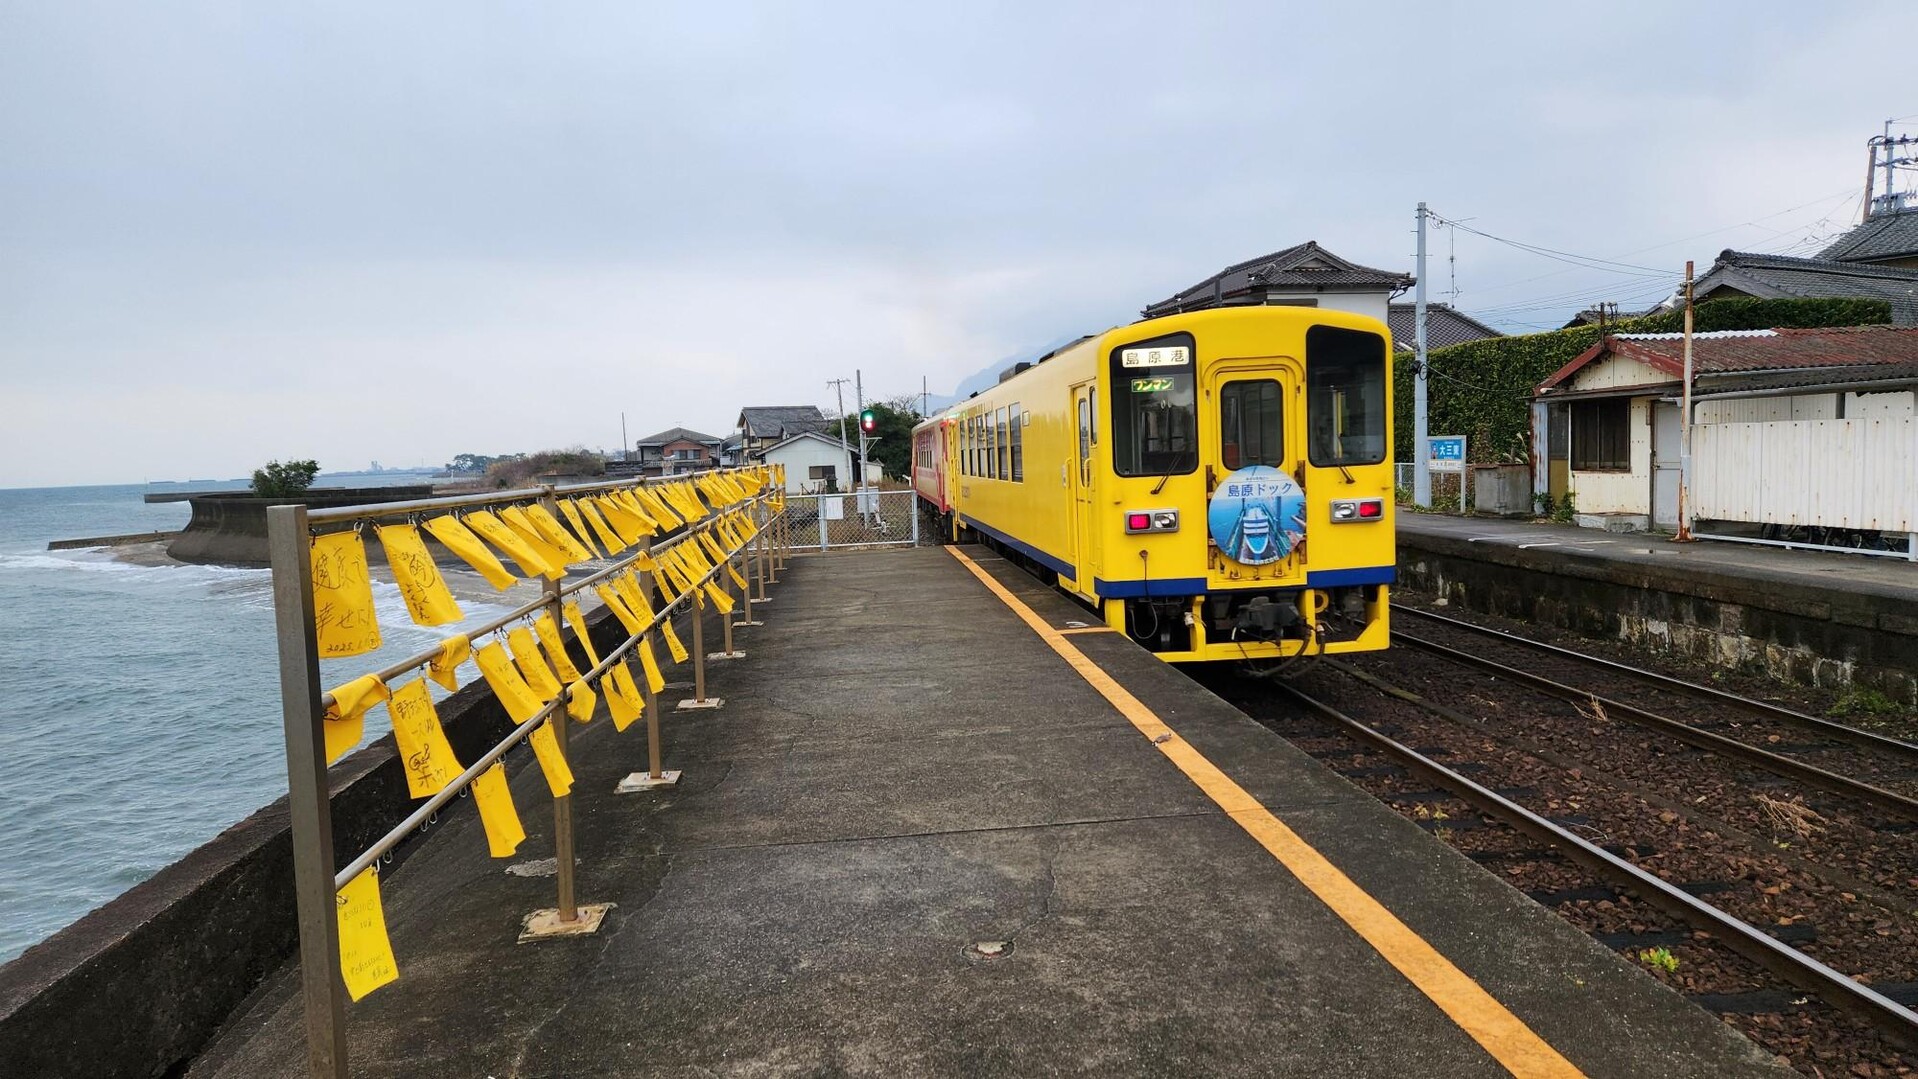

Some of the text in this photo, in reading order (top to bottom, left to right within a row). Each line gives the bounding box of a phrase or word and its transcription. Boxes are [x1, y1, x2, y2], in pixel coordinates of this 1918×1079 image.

[1126, 349, 1185, 366] 島原港
[1133, 379, 1172, 391] ワンマン
[1228, 482, 1293, 497] 島原ドック
